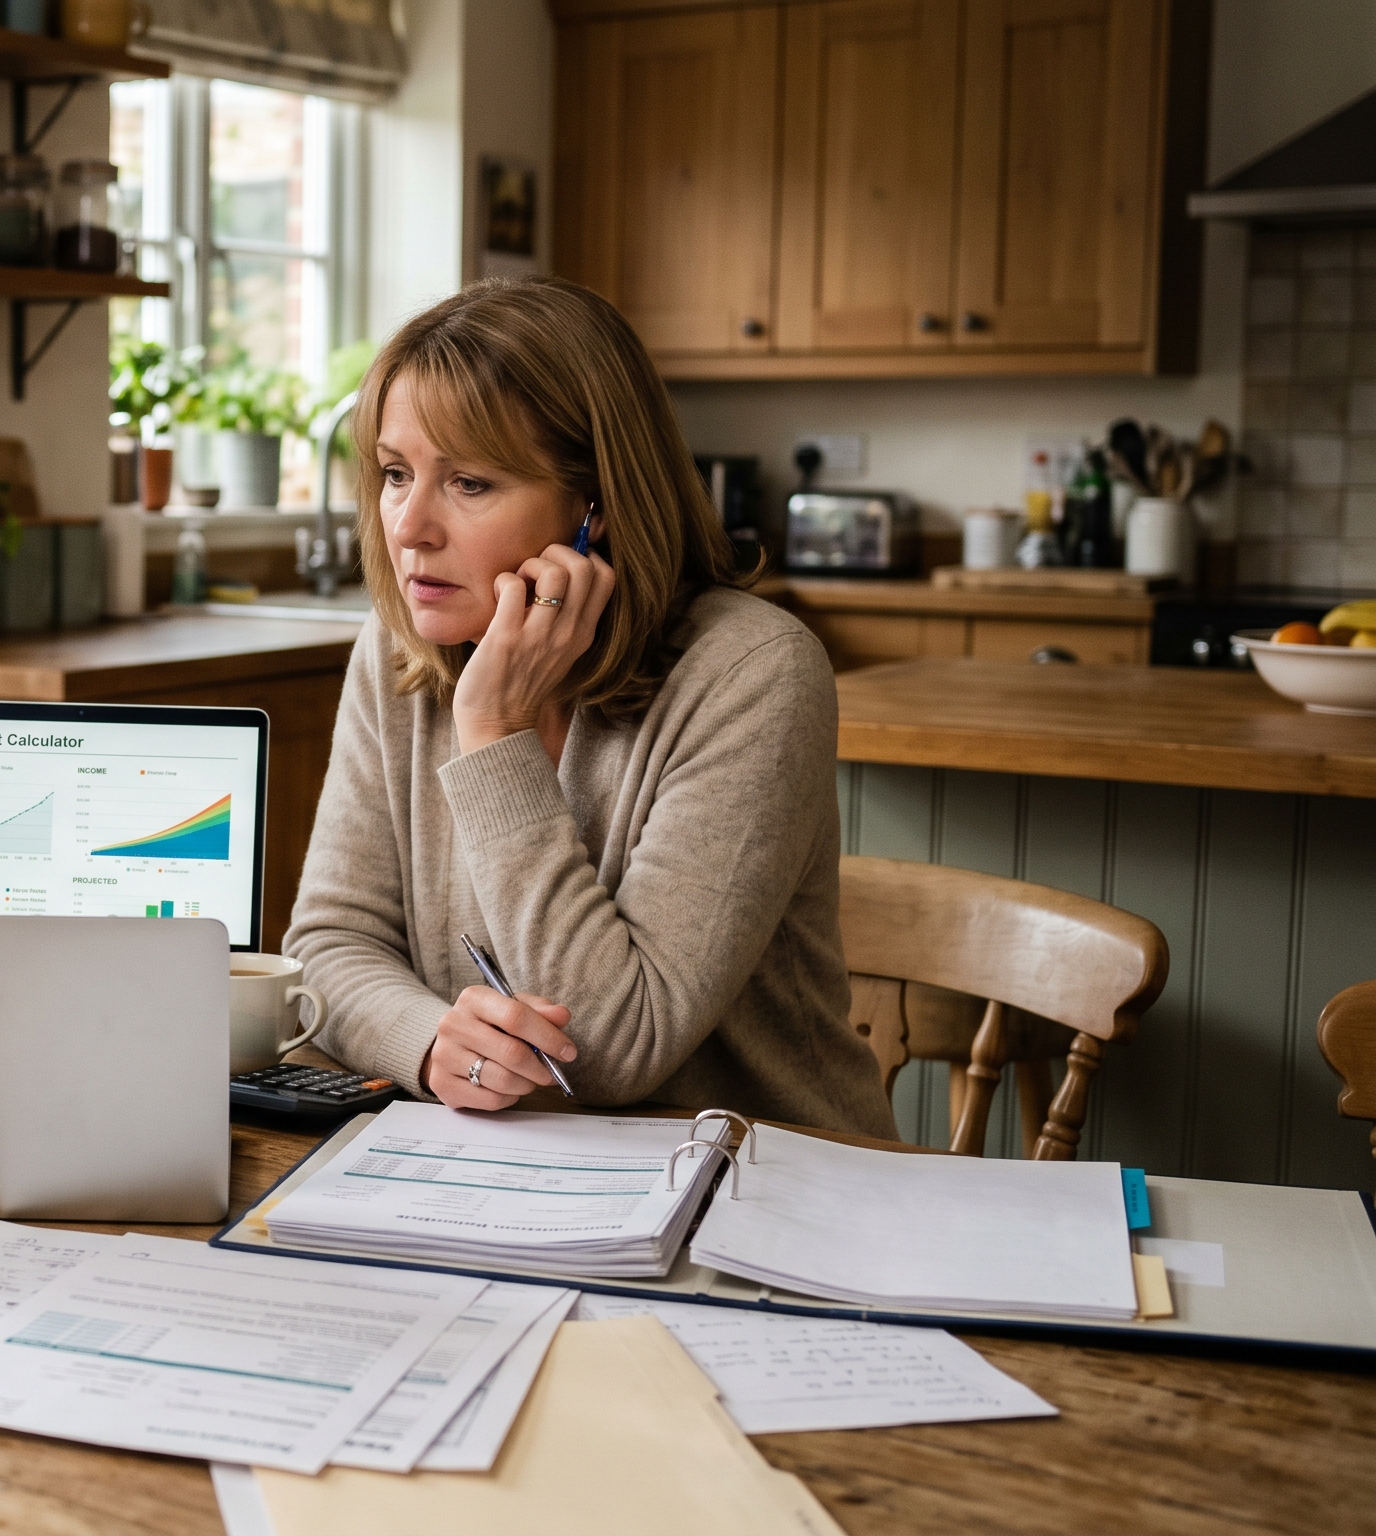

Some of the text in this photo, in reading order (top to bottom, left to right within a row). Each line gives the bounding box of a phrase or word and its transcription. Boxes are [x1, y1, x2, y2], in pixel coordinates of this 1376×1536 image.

[7, 733, 84, 748] Calculator
[77, 767, 107, 775] INCOME
[72, 877, 118, 885] PROJECTED
